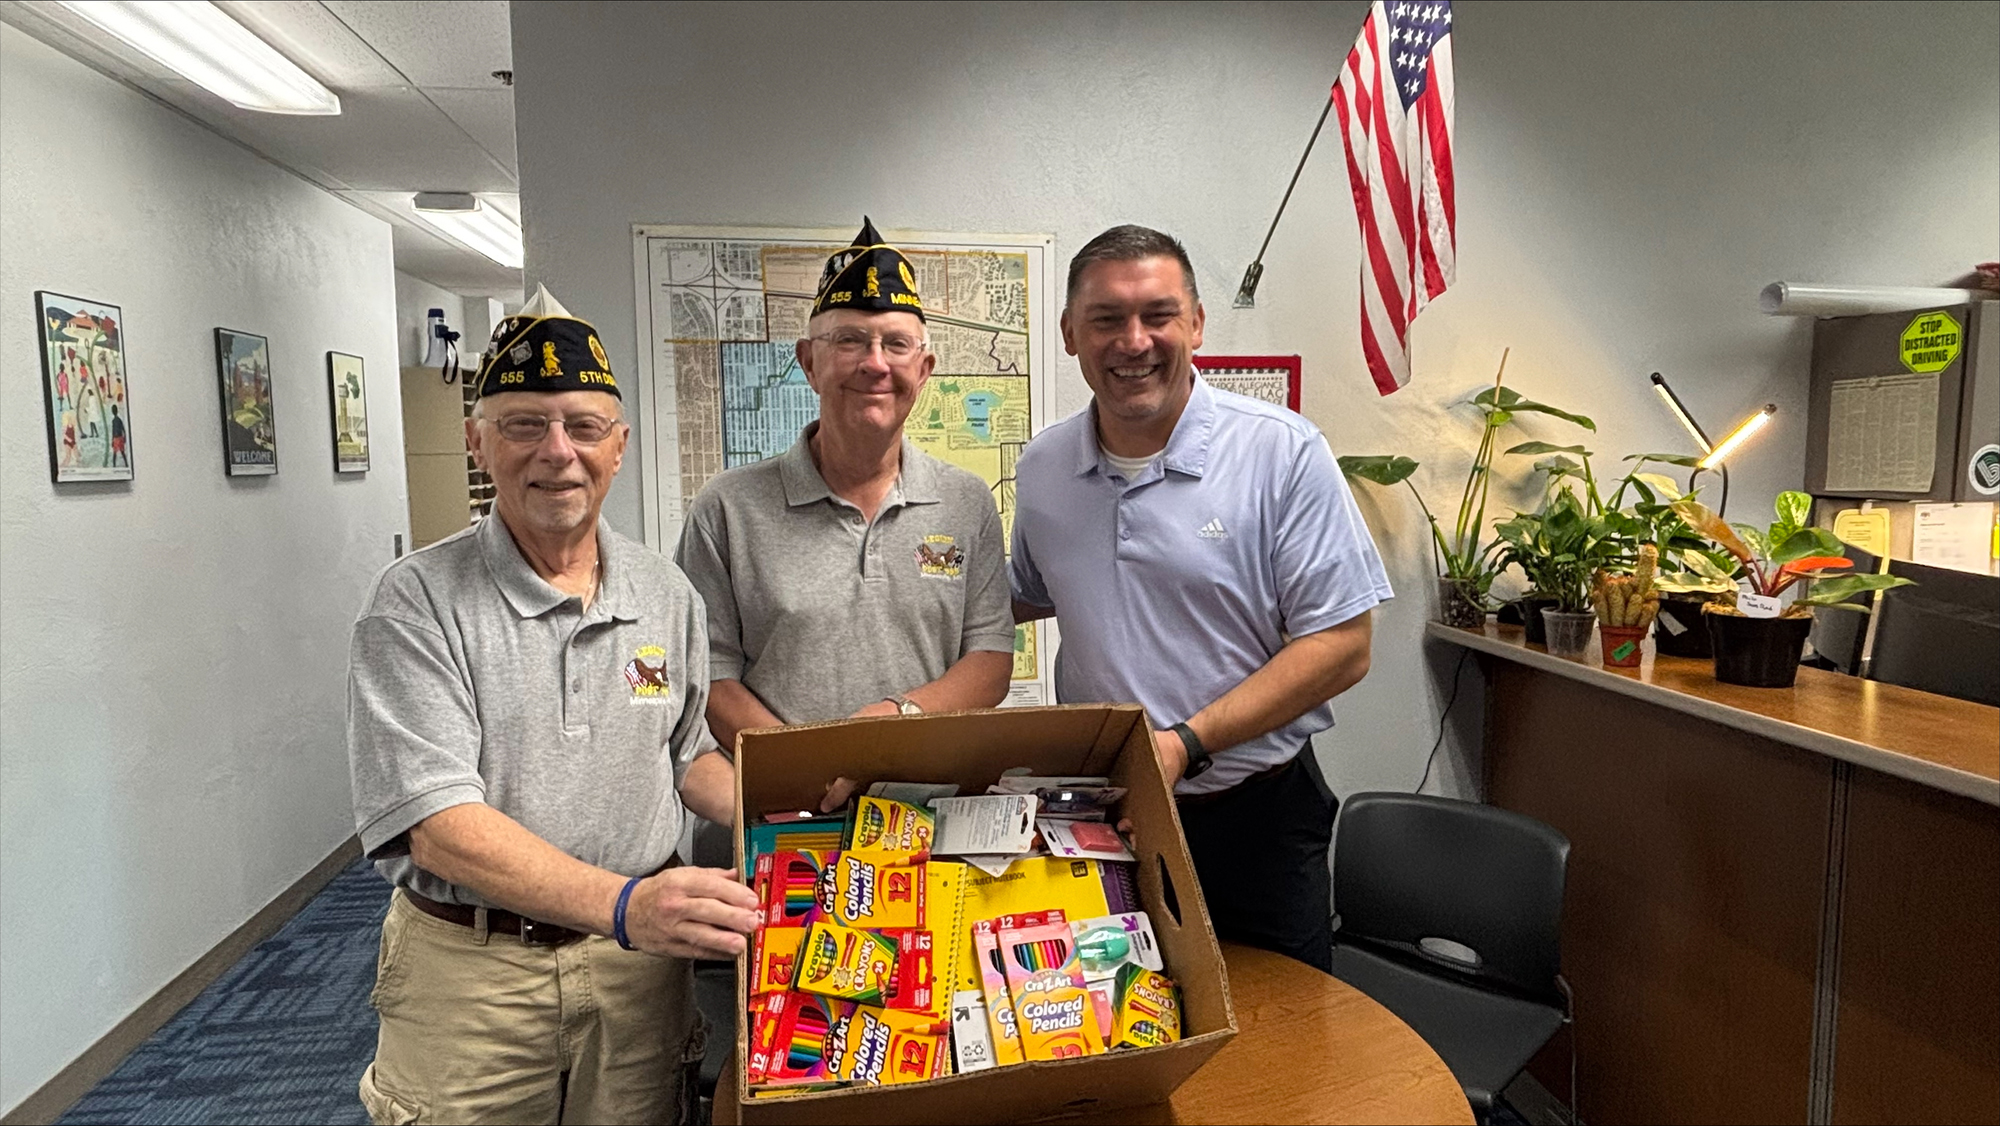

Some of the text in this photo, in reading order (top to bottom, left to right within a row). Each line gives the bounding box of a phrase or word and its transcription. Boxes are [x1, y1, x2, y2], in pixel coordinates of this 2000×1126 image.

[830, 291, 852, 303] 555
[1920, 320, 1942, 334] STOP
[1904, 333, 1957, 351] DISTRACTED
[1911, 349, 1949, 365] DRIVING
[500, 370, 525, 384] 555
[580, 371, 603, 384] 5TH
[1254, 388, 1283, 399] FLAG
[233, 450, 272, 463] WELCOME
[1196, 530, 1229, 539] adidas
[858, 804, 872, 844] Crayola
[901, 810, 917, 851] CRAYONS
[918, 827, 927, 838] 24
[993, 871, 1026, 883] NOTEBOOK
[844, 857, 861, 921] Colored
[859, 863, 875, 917] Pencils
[888, 871, 912, 903] 12
[976, 921, 991, 933] 12
[1000, 916, 1014, 929] 12
[920, 935, 931, 949] 12
[806, 931, 825, 979] Crayola
[768, 953, 793, 985] 12
[853, 939, 876, 991] CRAYONS
[874, 961, 885, 974] 24
[1133, 983, 1176, 1009] CRAYONS
[1022, 994, 1084, 1019] Colored
[1031, 1011, 1083, 1034] Pencils
[752, 1052, 767, 1072] 12
[865, 1022, 892, 1086] Pencils
[900, 1040, 928, 1078] 12
